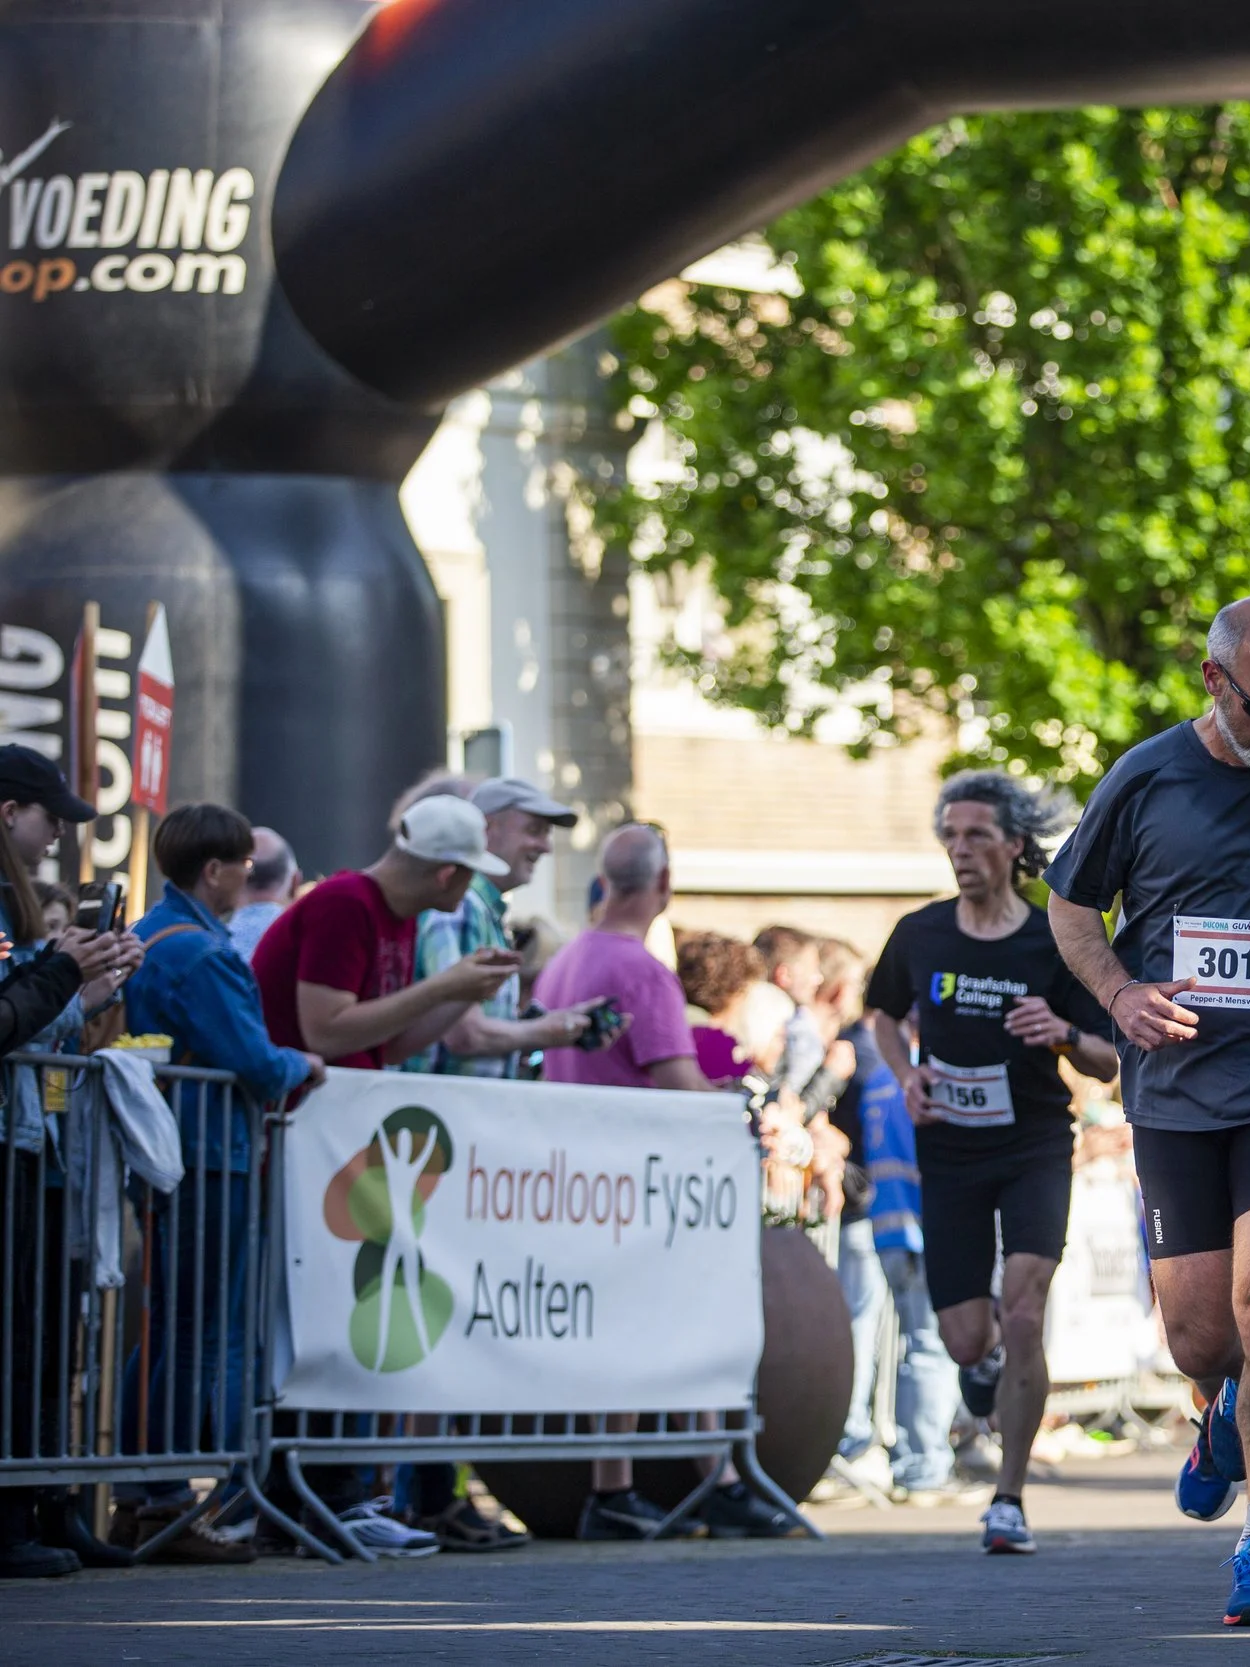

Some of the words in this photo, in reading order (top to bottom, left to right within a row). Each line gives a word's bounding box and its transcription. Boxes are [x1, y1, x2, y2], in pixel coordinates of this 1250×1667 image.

[8, 166, 255, 252] VOEDING
[1202, 921, 1229, 931] DUCONA
[956, 988, 1003, 1009] College
[1190, 994, 1223, 1004] Pepper-8
[946, 1083, 987, 1107] 156
[1152, 1208, 1164, 1245] FUSION
[464, 1255, 595, 1340] Aalten
